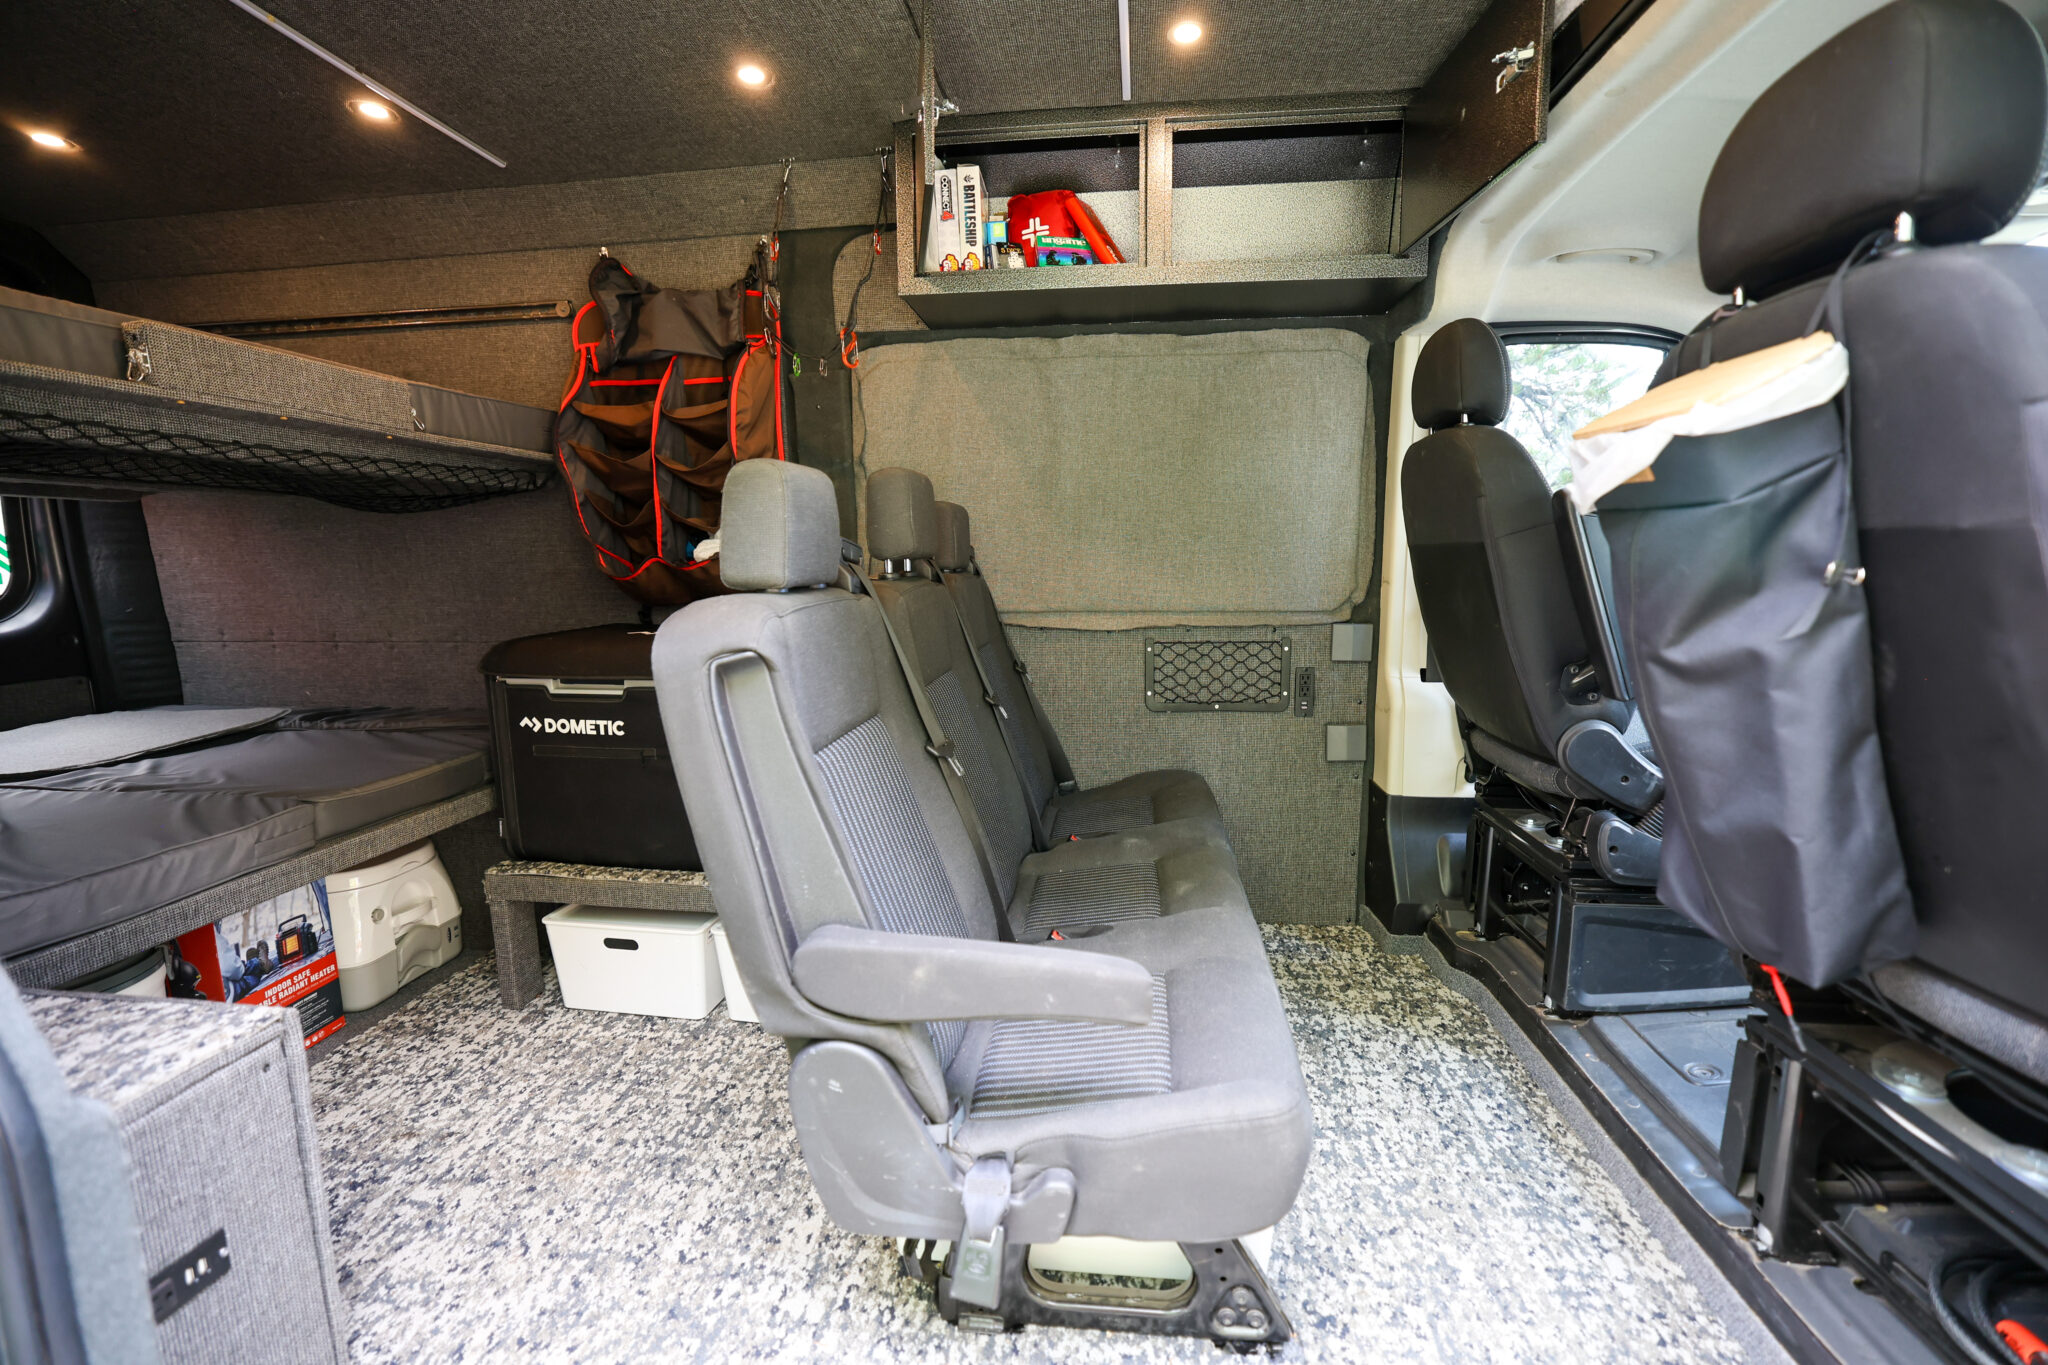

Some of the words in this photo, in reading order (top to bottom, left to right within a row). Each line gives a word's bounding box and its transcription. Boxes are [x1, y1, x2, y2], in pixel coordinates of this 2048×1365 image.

[963, 184, 977, 247] BATTLESHIP
[543, 717, 625, 737] DOMETIC
[264, 979, 292, 998] INDOOR
[293, 969, 311, 983] SAFE
[278, 978, 309, 1000] RADIANT
[310, 965, 335, 982] HEATER
